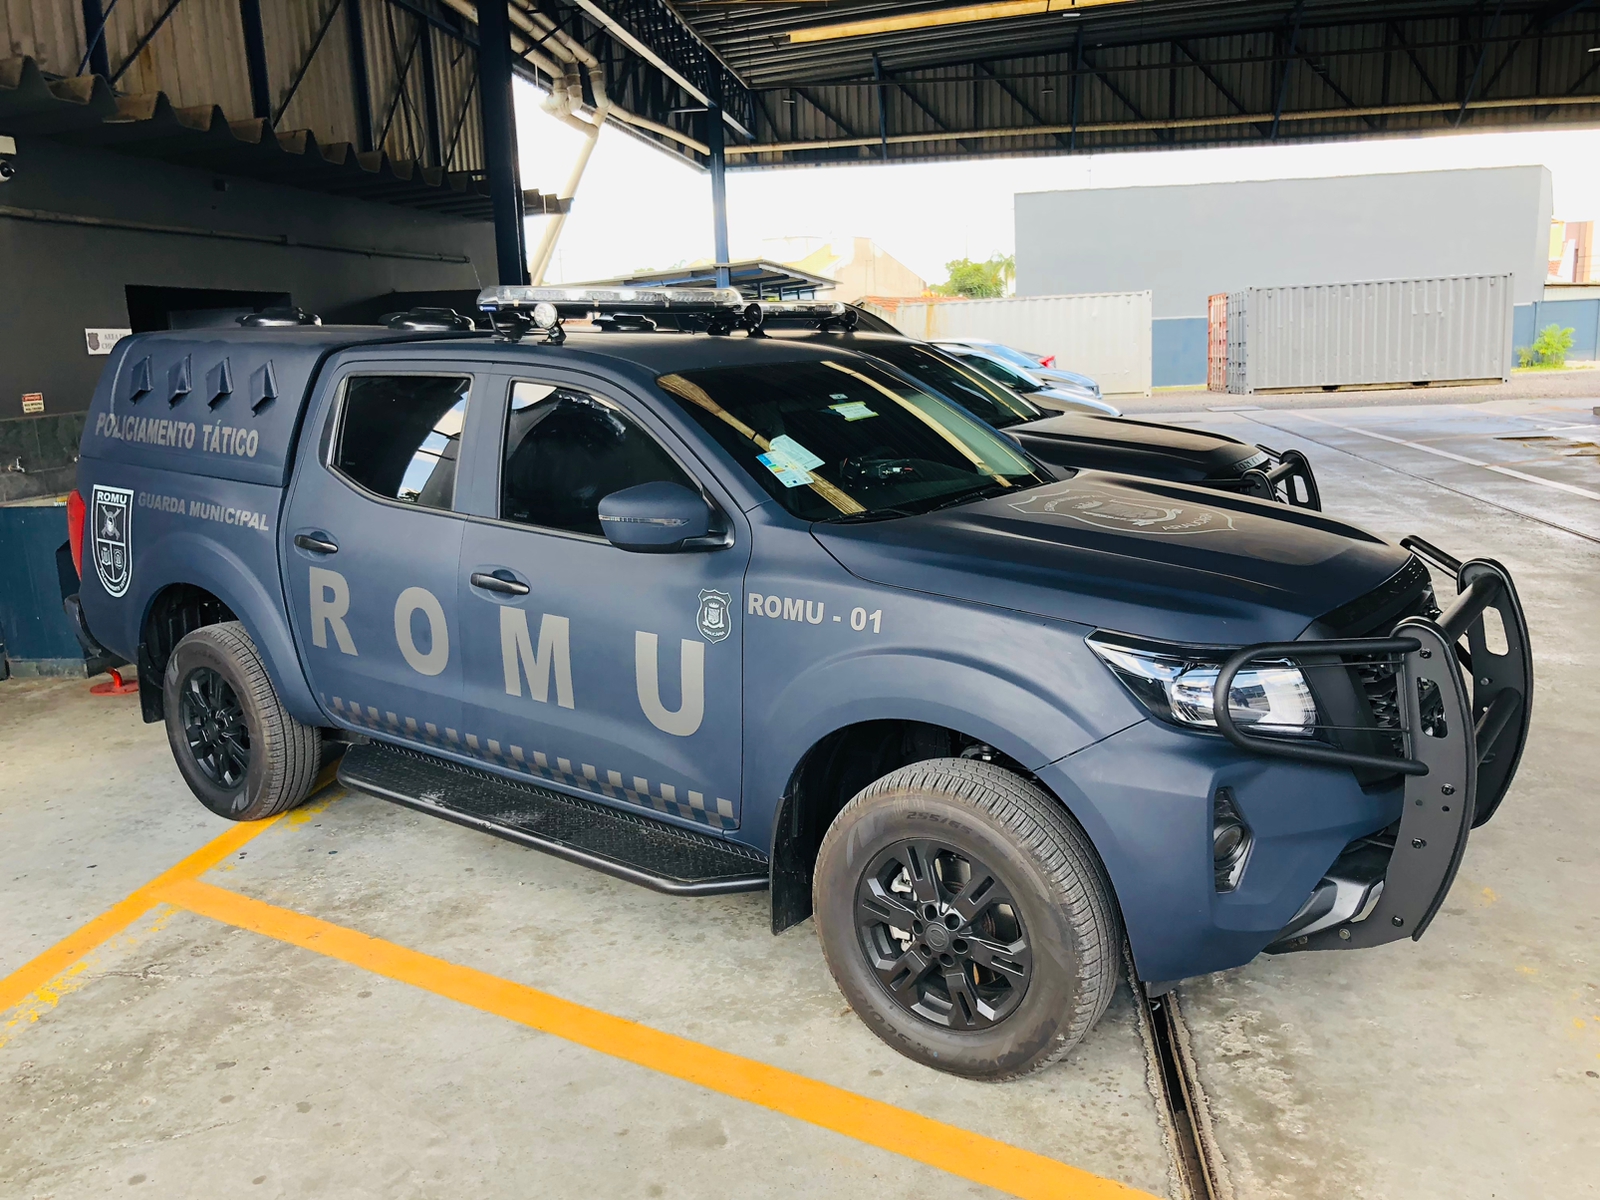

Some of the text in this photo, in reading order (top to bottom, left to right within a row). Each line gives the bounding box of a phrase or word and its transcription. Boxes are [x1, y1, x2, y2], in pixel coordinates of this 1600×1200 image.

[95, 412, 259, 458] POLICIAMENTO TÁTICO
[97, 491, 128, 504] ROMU
[138, 492, 269, 531] GUARDA MUNICIPAL
[747, 592, 825, 625] ROMU
[850, 607, 883, 634] 01
